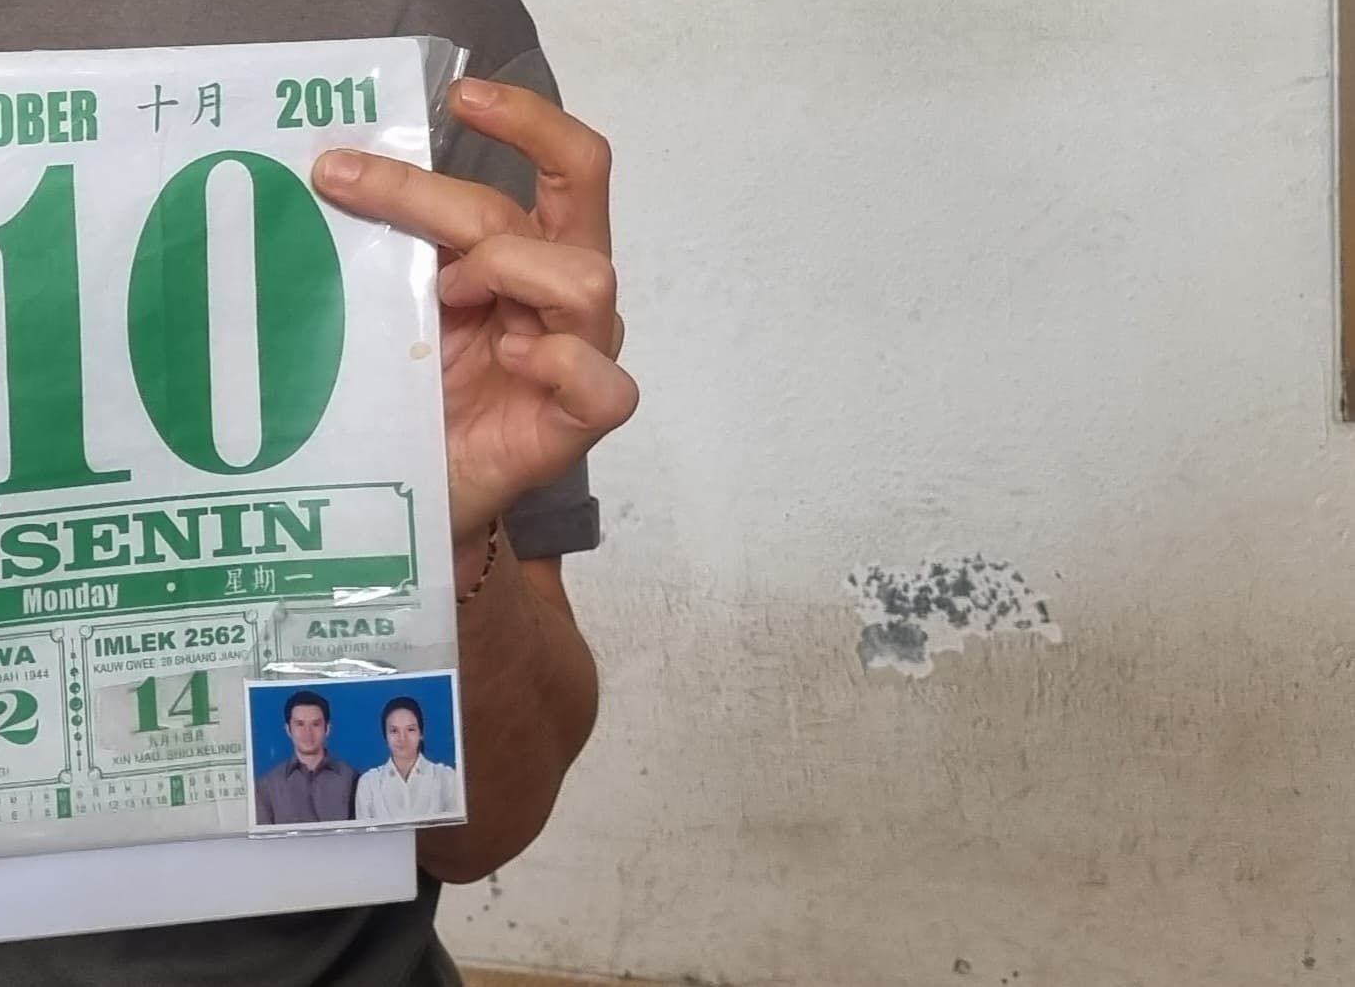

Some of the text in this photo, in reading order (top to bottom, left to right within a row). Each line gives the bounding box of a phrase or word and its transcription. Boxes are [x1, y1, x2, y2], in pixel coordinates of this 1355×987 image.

[138, 81, 223, 133] 十月
[276, 77, 378, 129] 2011
[0, 498, 330, 581] SENIN
[222, 564, 314, 596] 星期一
[22, 582, 120, 615] Monday
[95, 624, 246, 657] IMLEK 2562
[306, 617, 395, 639] ARAB
[24, 668, 50, 682] 1944
[93, 660, 124, 673] KAUW
[127, 669, 220, 735] 14
[112, 755, 131, 766] XIN
